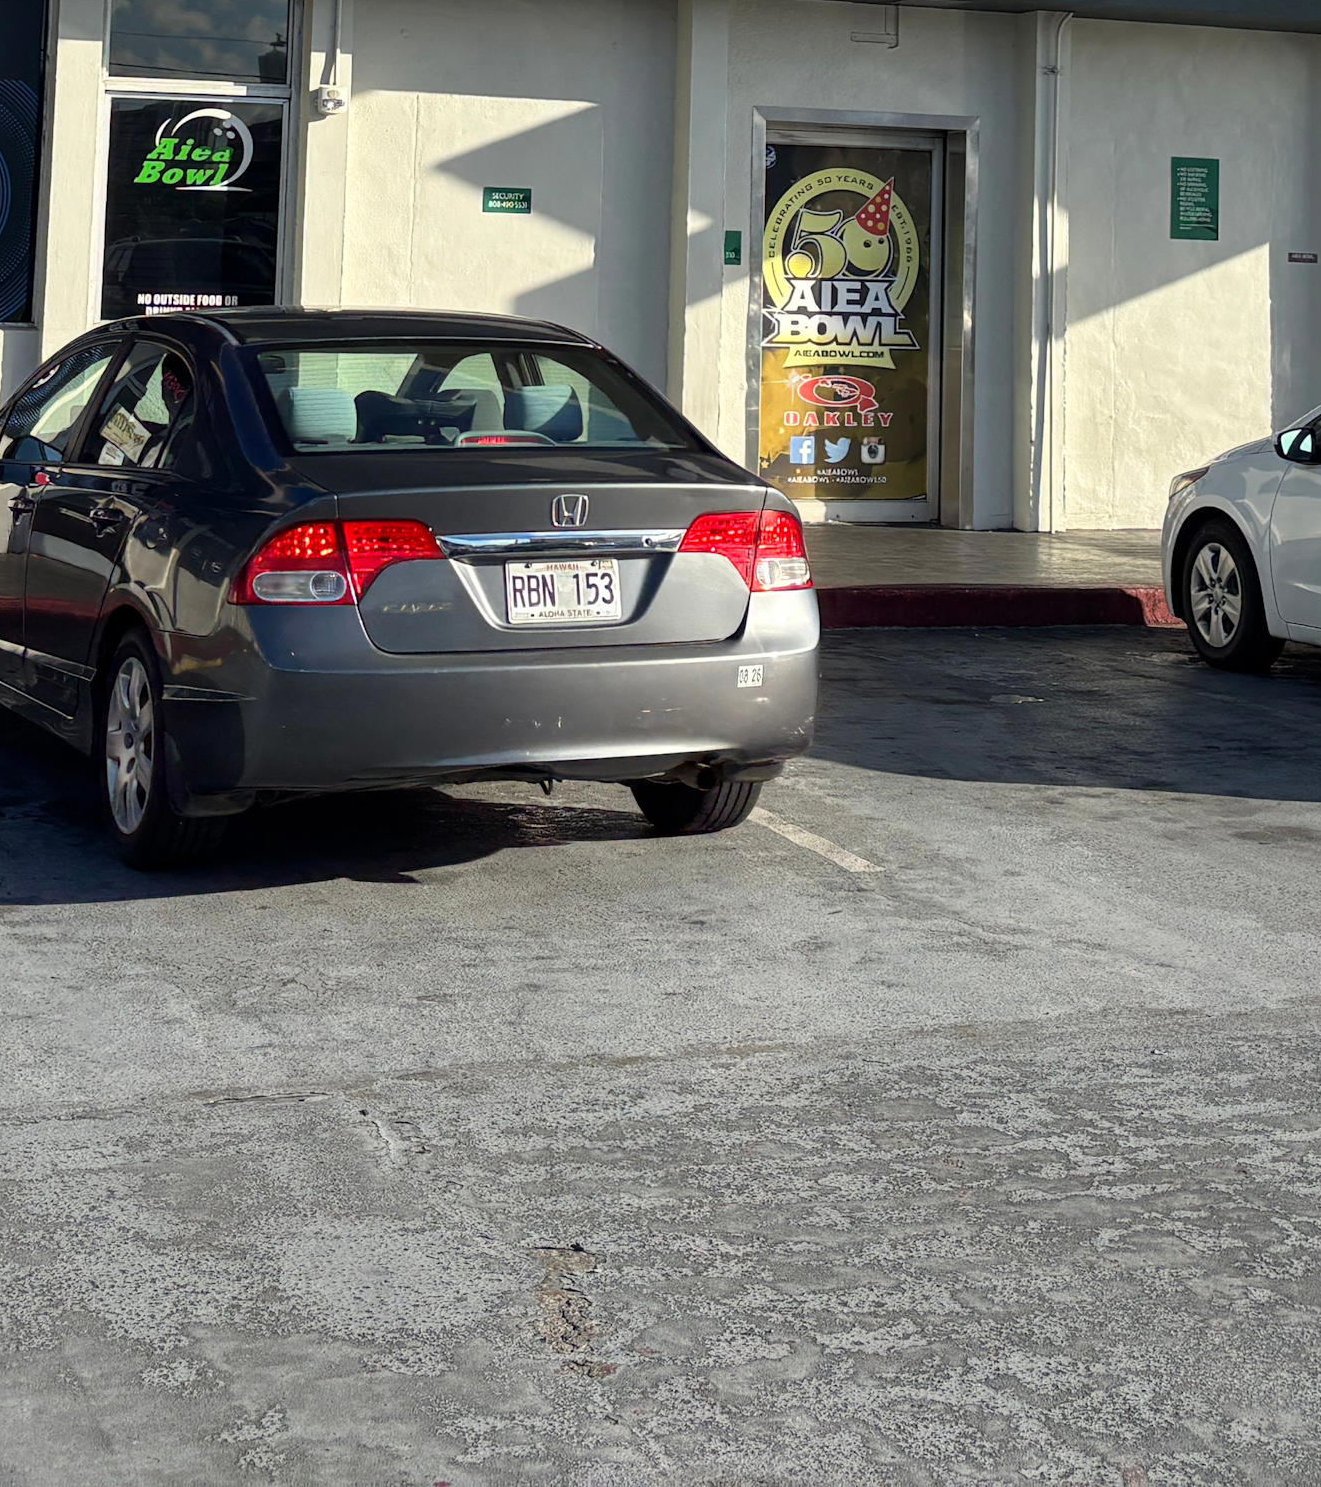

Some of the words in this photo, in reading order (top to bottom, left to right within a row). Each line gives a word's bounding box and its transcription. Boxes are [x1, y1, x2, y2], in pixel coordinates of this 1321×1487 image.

[146, 138, 234, 162] Aiea
[134, 161, 230, 186] Bowl
[491, 192, 525, 200] SECURITY
[768, 183, 813, 258] CELEBRATING
[817, 176, 832, 186] 50
[836, 175, 874, 191] YEARS
[137, 293, 152, 305] NO
[153, 294, 195, 306] OUTSIDE
[197, 294, 222, 306] FOOD
[224, 295, 239, 306] OR
[783, 279, 896, 313] AIEA
[772, 314, 914, 345] BOWL
[793, 349, 884, 359] AIEABOWL.COM
[783, 411, 894, 427] OAKLEY
[512, 574, 557, 608] RBN
[572, 572, 615, 606] 153
[539, 609, 565, 618] ALOHA
[567, 608, 592, 617] STATE
